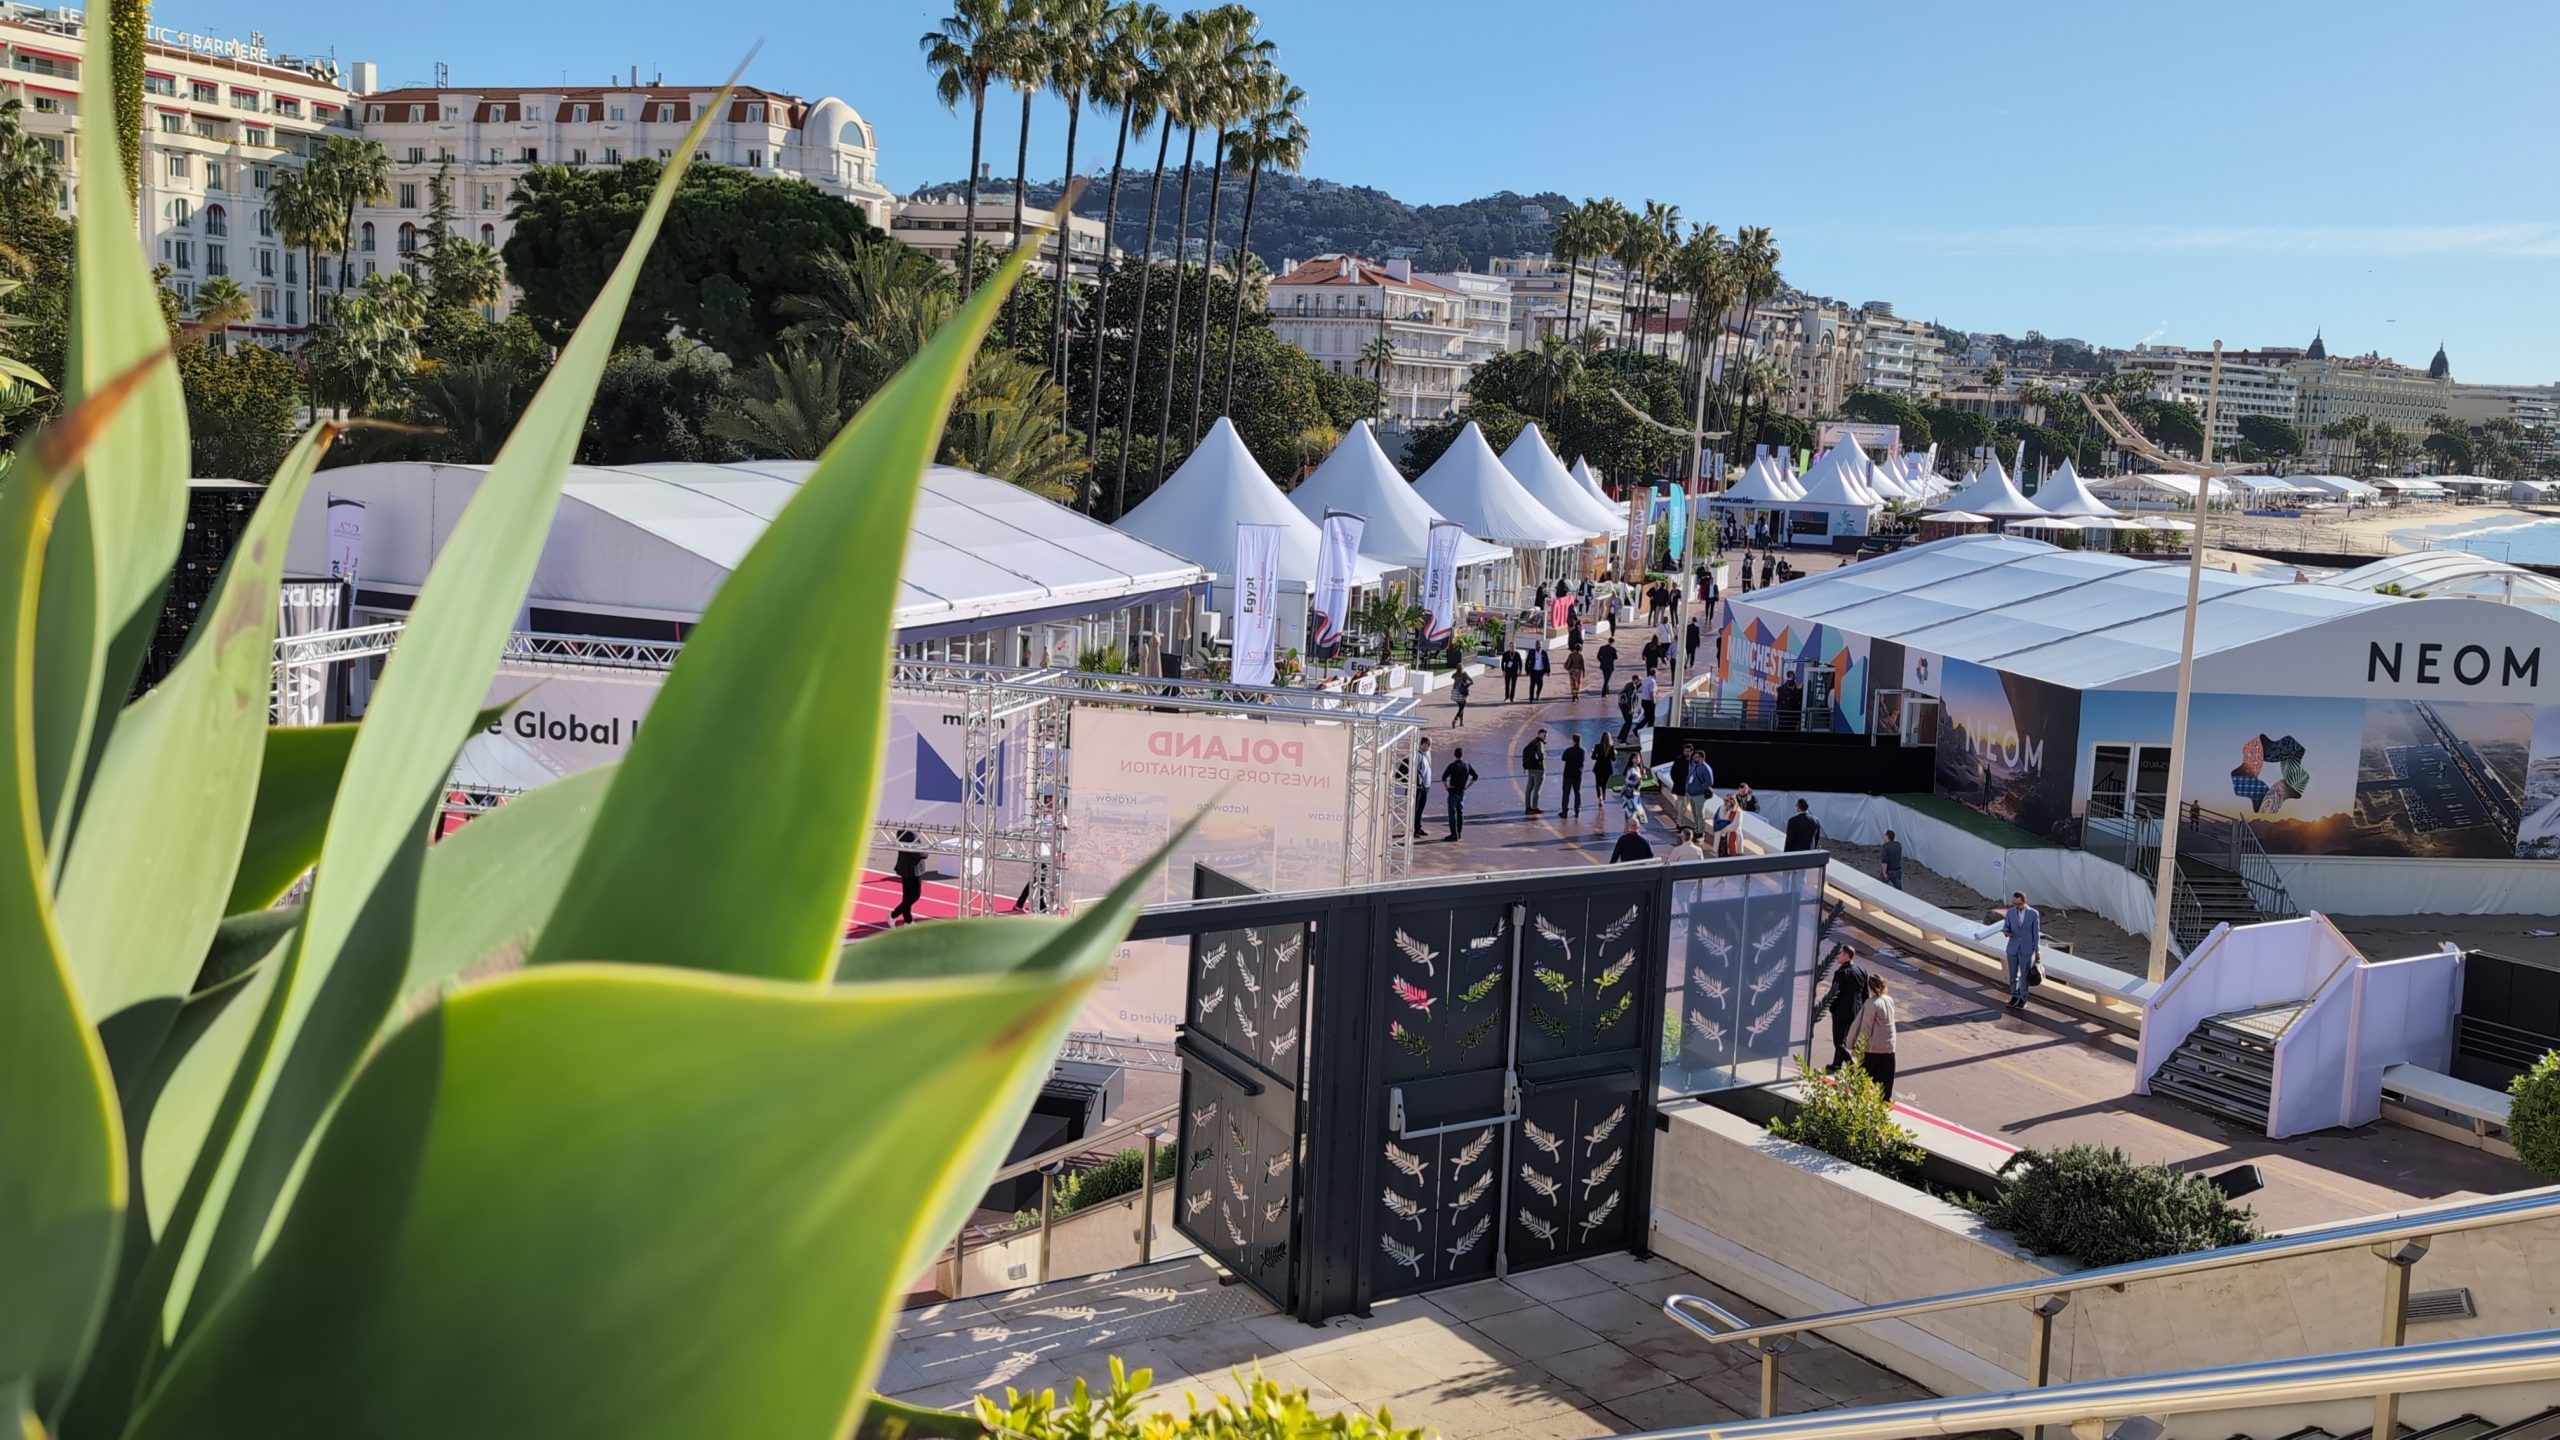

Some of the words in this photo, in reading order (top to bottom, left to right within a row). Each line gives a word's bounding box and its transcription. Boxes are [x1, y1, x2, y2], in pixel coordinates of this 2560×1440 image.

[59, 6, 83, 24] LE
[1631, 509, 1646, 560] OMAN
[1243, 577, 1257, 613] Egypt
[1429, 569, 1439, 598] Egypt
[2368, 641, 2541, 687] NEOM
[514, 711, 618, 745] Global
[1965, 716, 2044, 777] NEOM
